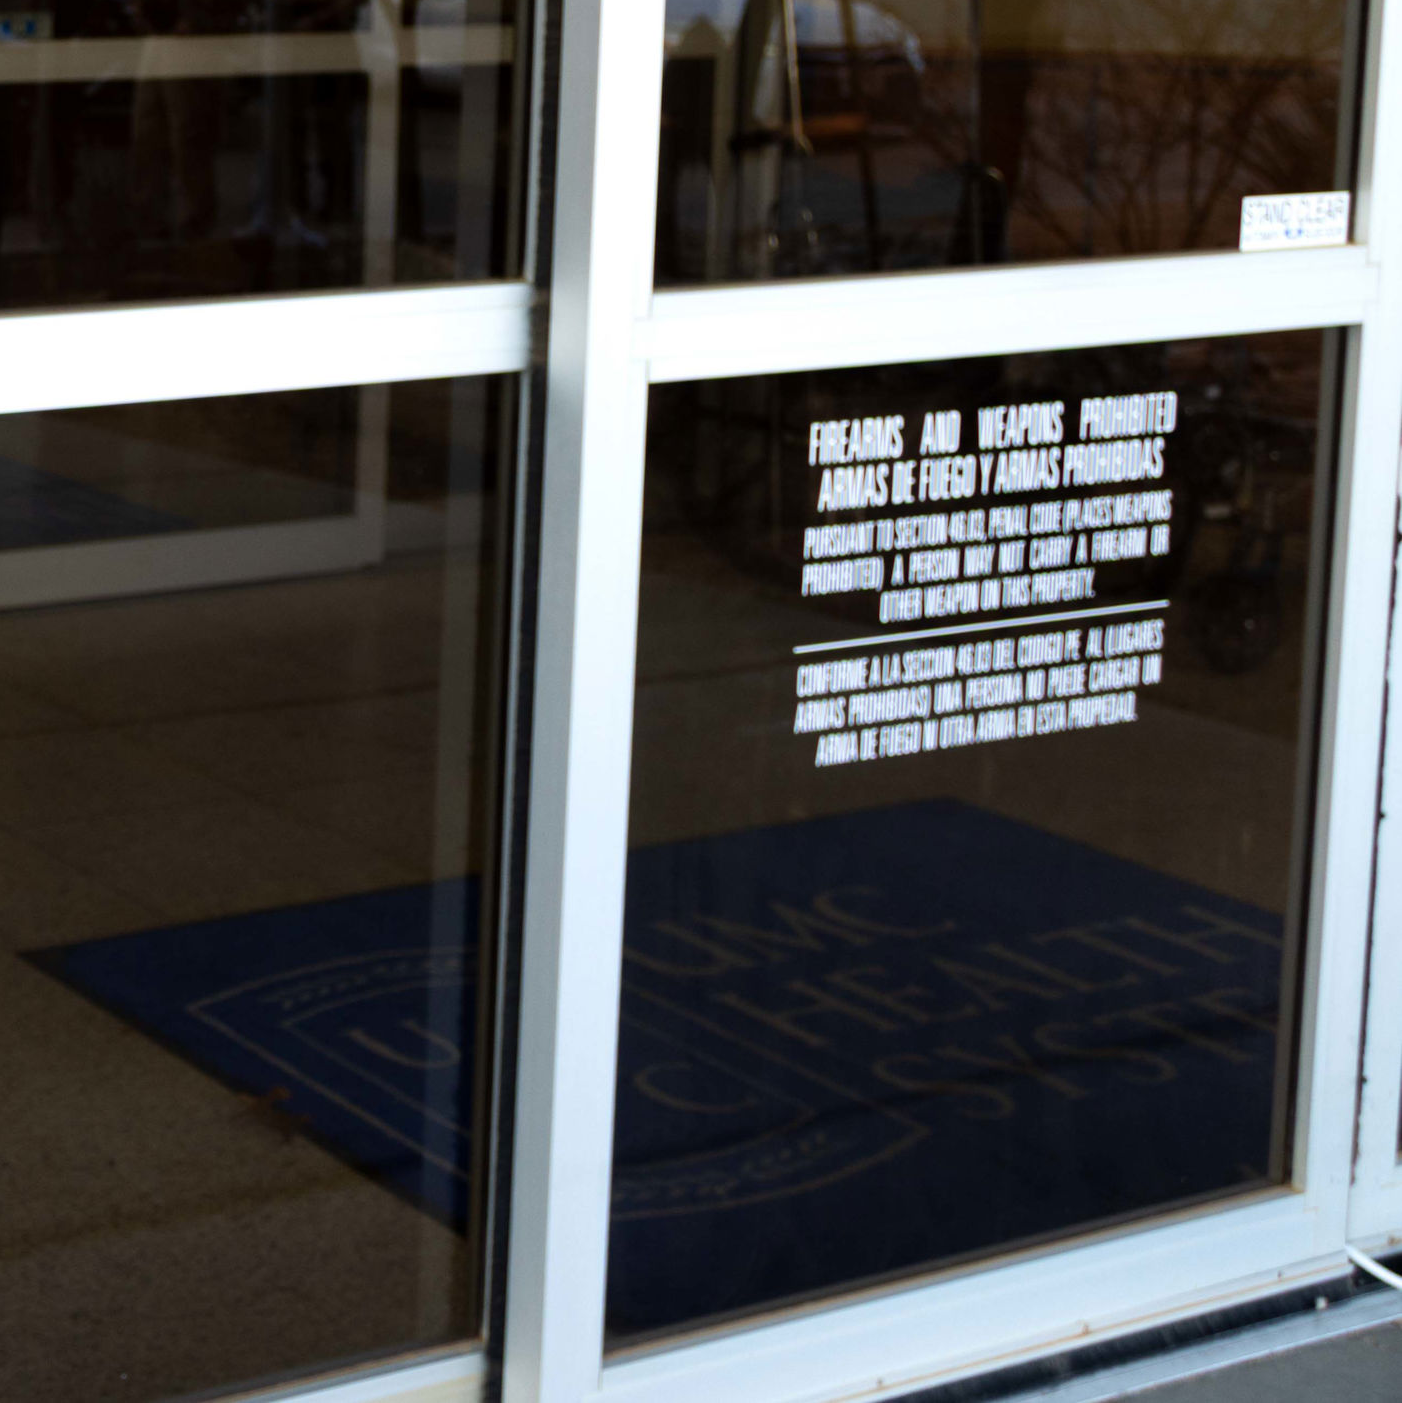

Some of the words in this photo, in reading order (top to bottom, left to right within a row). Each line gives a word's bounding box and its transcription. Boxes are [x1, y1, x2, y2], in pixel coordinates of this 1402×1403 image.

[809, 415, 904, 466] FIREARMS
[920, 410, 961, 455] AND
[978, 401, 1065, 449] WEAPONS
[1079, 391, 1177, 440] PROHIBITED
[817, 463, 889, 512] ARMAS
[891, 460, 917, 504] DE
[919, 454, 976, 502] FUEGO
[980, 452, 994, 495] Y
[994, 446, 1061, 494] ARMAS
[1063, 436, 1165, 487] PROHIBIDAS
